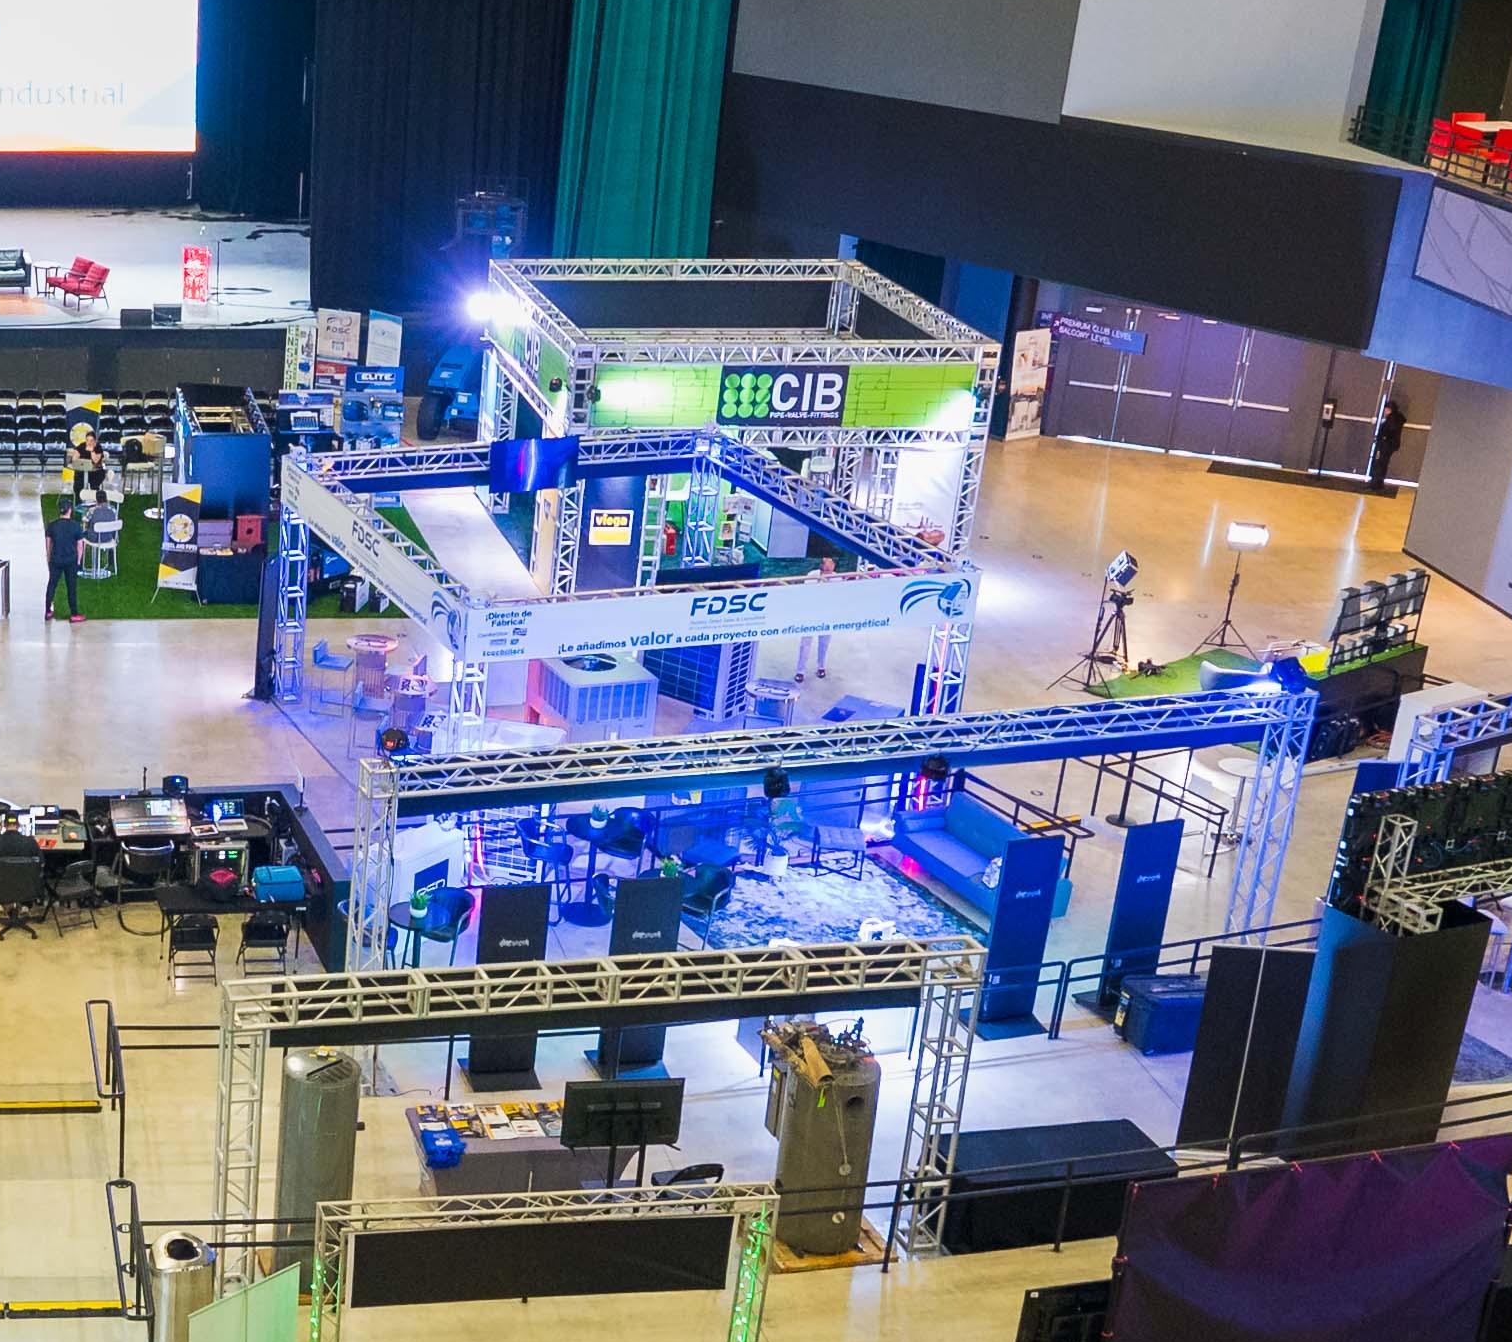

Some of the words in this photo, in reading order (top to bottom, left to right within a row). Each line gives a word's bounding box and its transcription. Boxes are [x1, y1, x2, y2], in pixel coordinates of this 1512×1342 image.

[1058, 326, 1090, 339] BALCONY
[1090, 334, 1112, 345] LEVEL
[1059, 316, 1091, 331] PREMIUM
[1092, 324, 1111, 336] CLUB
[1111, 330, 1133, 341] LEVEL
[770, 372, 844, 413] CIB
[595, 513, 628, 527] viega
[351, 520, 381, 558] FDSC
[522, 609, 533, 619] de
[690, 592, 768, 617] FDSC
[558, 642, 574, 654] ¡Le
[576, 640, 626, 652] añadimos
[630, 631, 674, 647] valor
[684, 632, 710, 643] cada
[712, 629, 758, 643] proyecto
[760, 627, 779, 637] con
[781, 621, 830, 635] eficiencia
[832, 617, 890, 632] energética!
